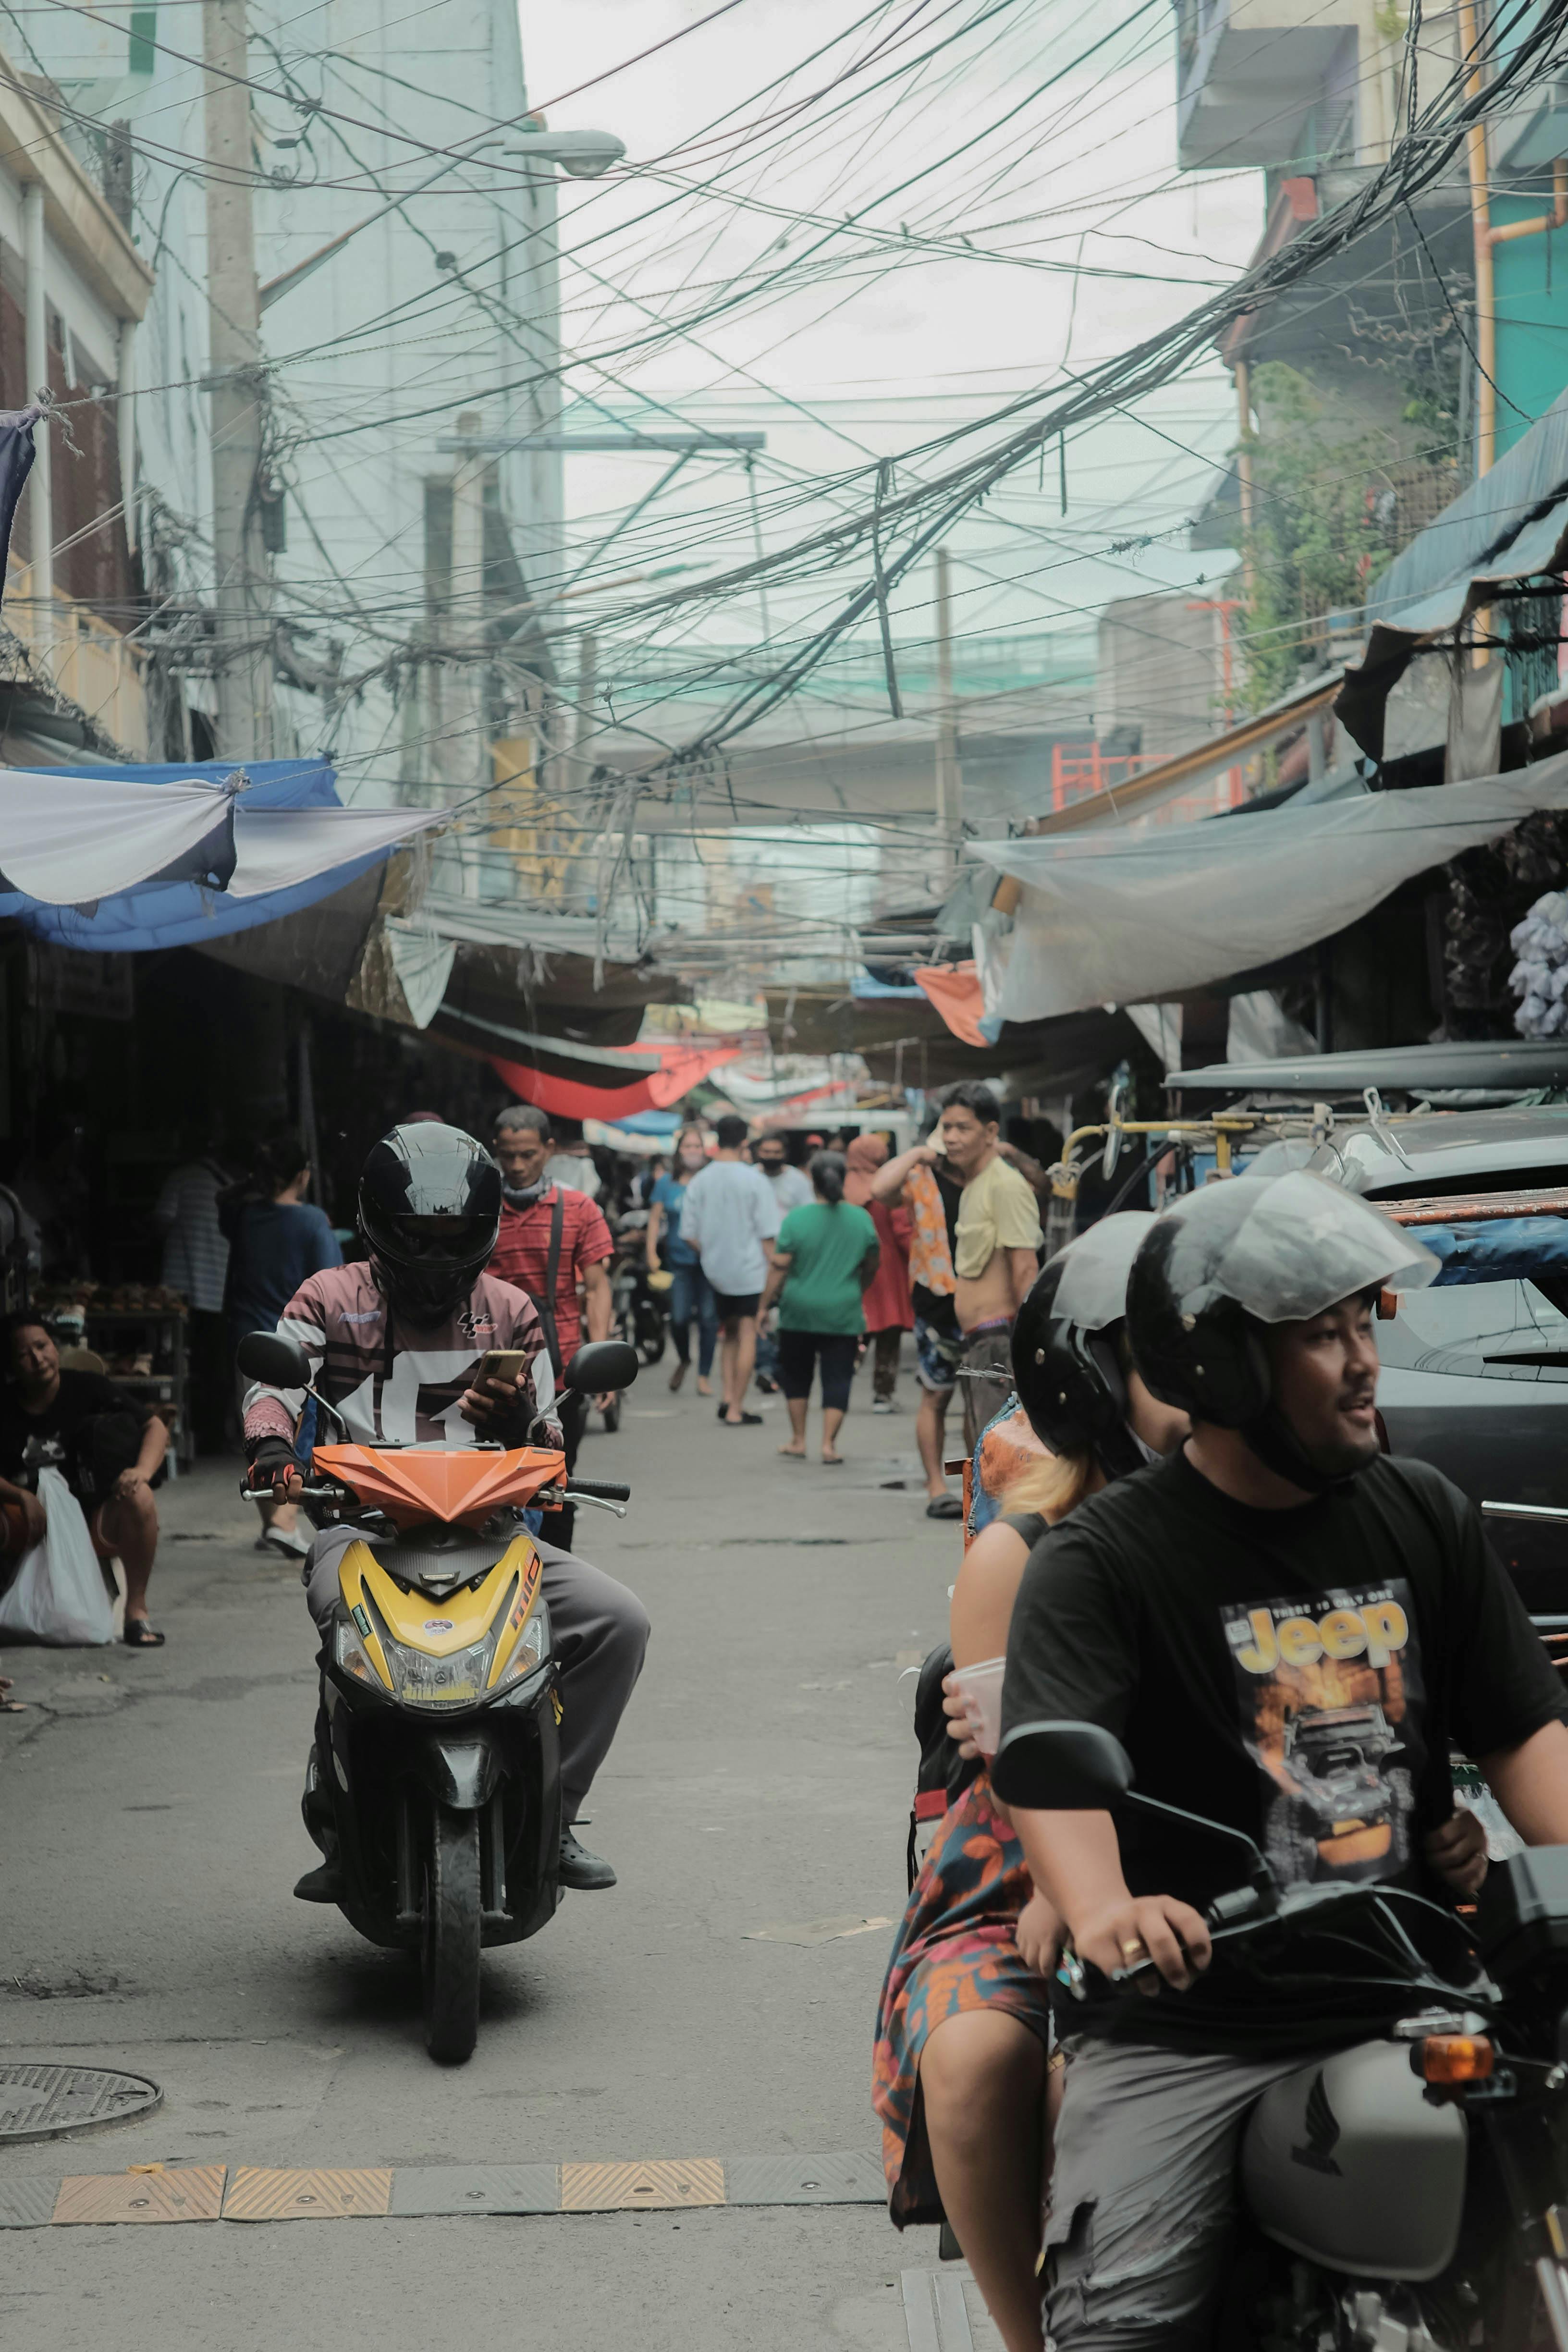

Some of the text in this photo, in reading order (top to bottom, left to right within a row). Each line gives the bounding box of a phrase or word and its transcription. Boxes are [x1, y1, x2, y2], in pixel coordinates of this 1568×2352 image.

[1274, 1604, 1311, 1618] THERE
[1333, 1594, 1364, 1608] ONLY
[1368, 1589, 1394, 1602] ONE
[1236, 1601, 1409, 1674] Jeep
